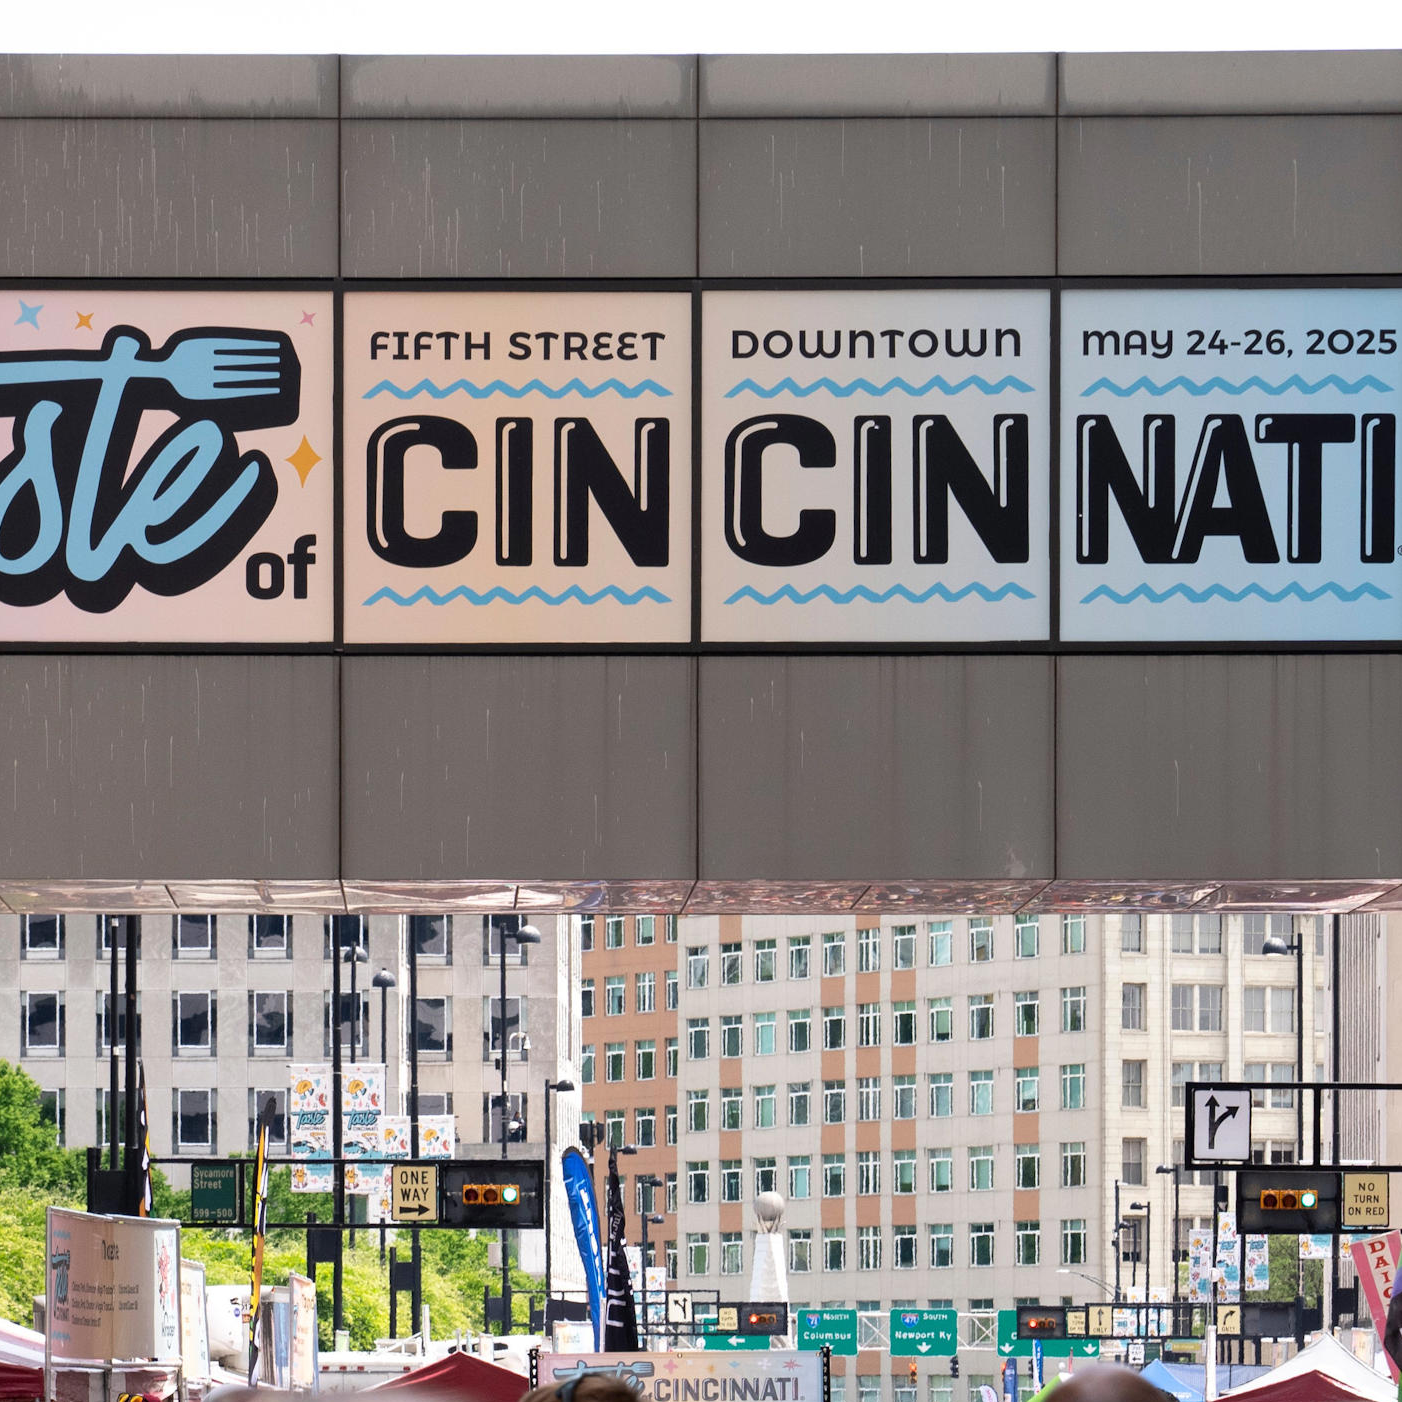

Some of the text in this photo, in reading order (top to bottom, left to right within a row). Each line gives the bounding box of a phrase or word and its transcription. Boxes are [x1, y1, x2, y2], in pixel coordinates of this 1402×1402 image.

[370, 331, 666, 361] FIFTH STREET
[731, 327, 1022, 360] DOWNTOWN
[1082, 328, 1398, 359] MAY 24-26, 2025
[366, 414, 670, 568] CIN
[724, 413, 1030, 567] CIN
[246, 534, 317, 600] of
[193, 1168, 234, 1180] Sycamore
[400, 1171, 429, 1185] ONE
[193, 1179, 222, 1190] Street
[1358, 1183, 1375, 1191] NO
[400, 1188, 430, 1202] WAY
[1353, 1195, 1379, 1203] TURN
[1348, 1207, 1385, 1216] ON RED
[803, 1331, 852, 1340] Columbus
[894, 1331, 952, 1341] Newport Ky
